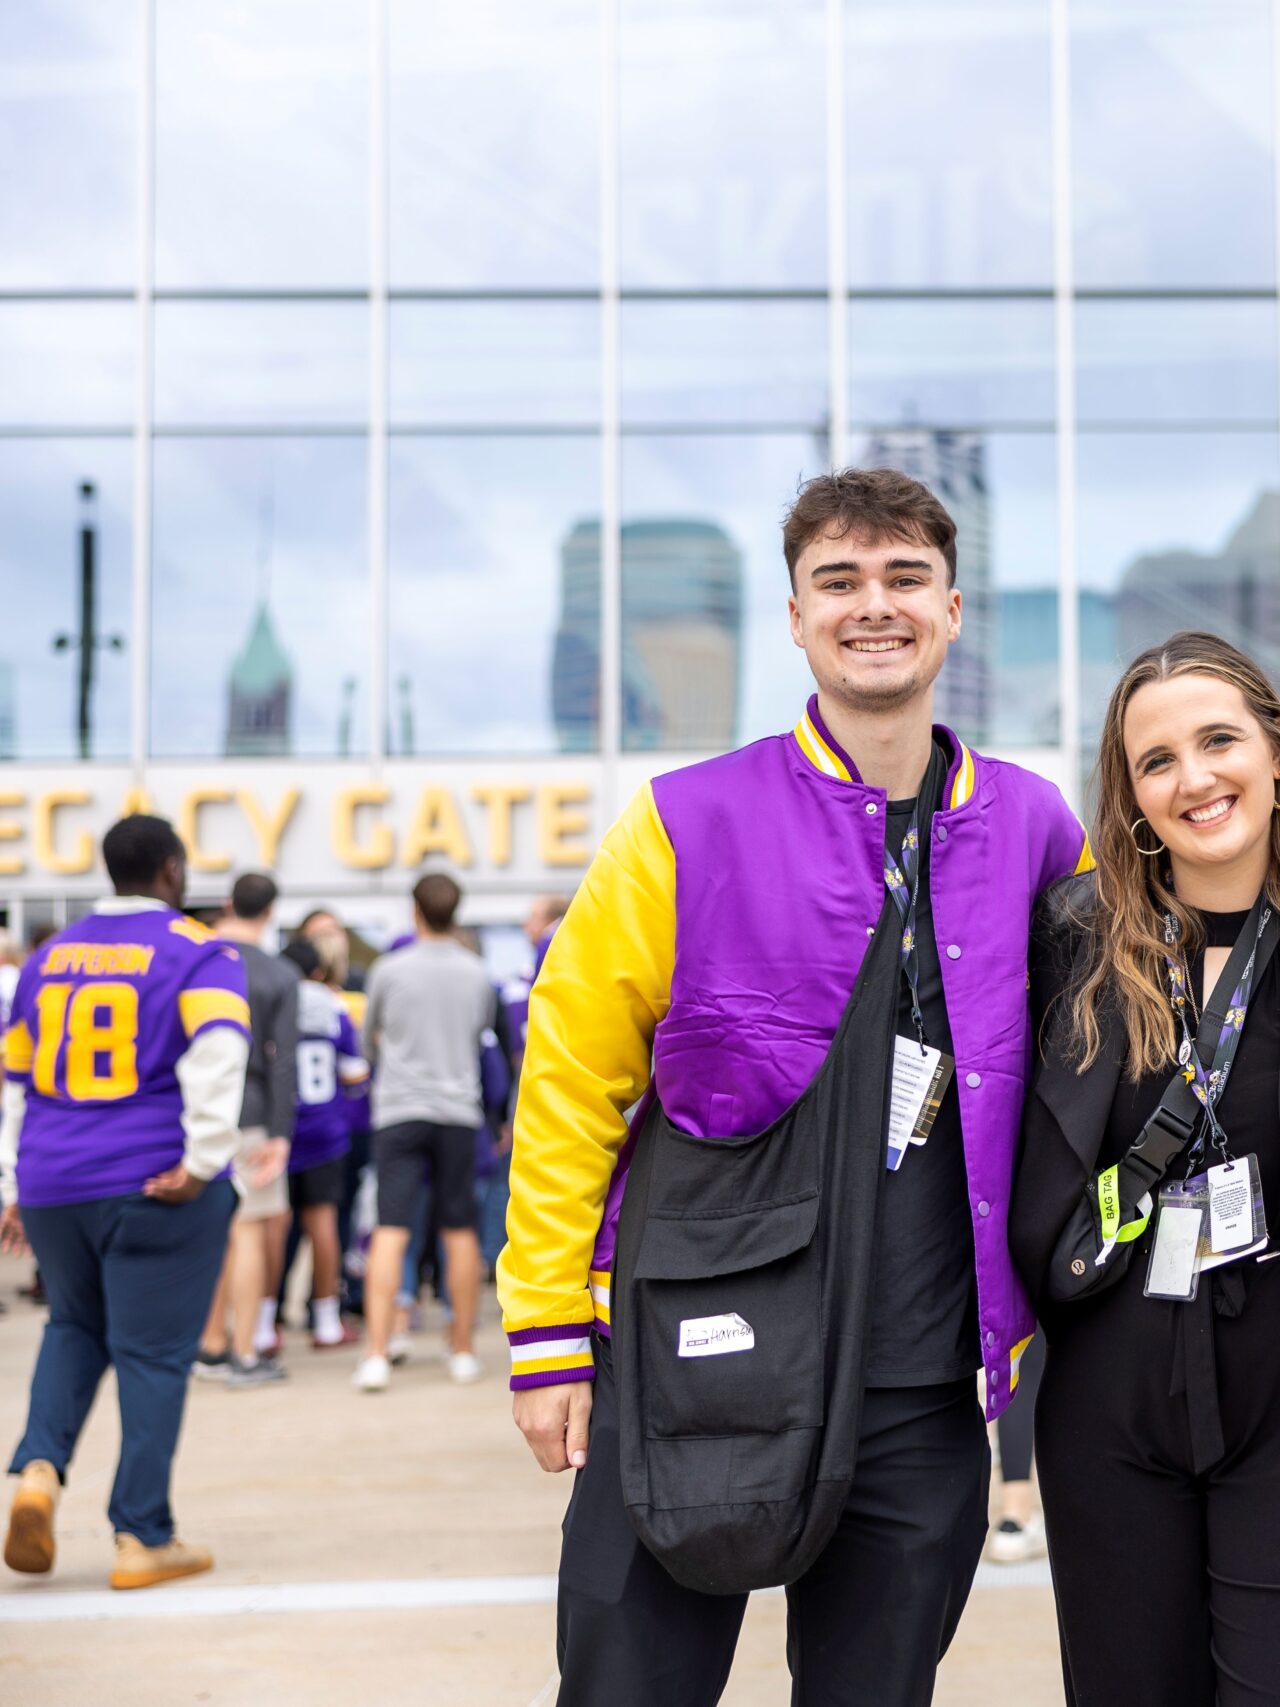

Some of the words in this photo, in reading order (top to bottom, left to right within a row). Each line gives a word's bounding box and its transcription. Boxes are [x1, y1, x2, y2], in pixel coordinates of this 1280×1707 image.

[331, 785, 593, 867] GATE
[40, 943, 155, 976] JEFFERSON
[32, 981, 139, 1101] 18
[1217, 1061, 1230, 1092] stadium
[1103, 1174, 1112, 1193] TAG
[1104, 1196, 1115, 1220] BAG
